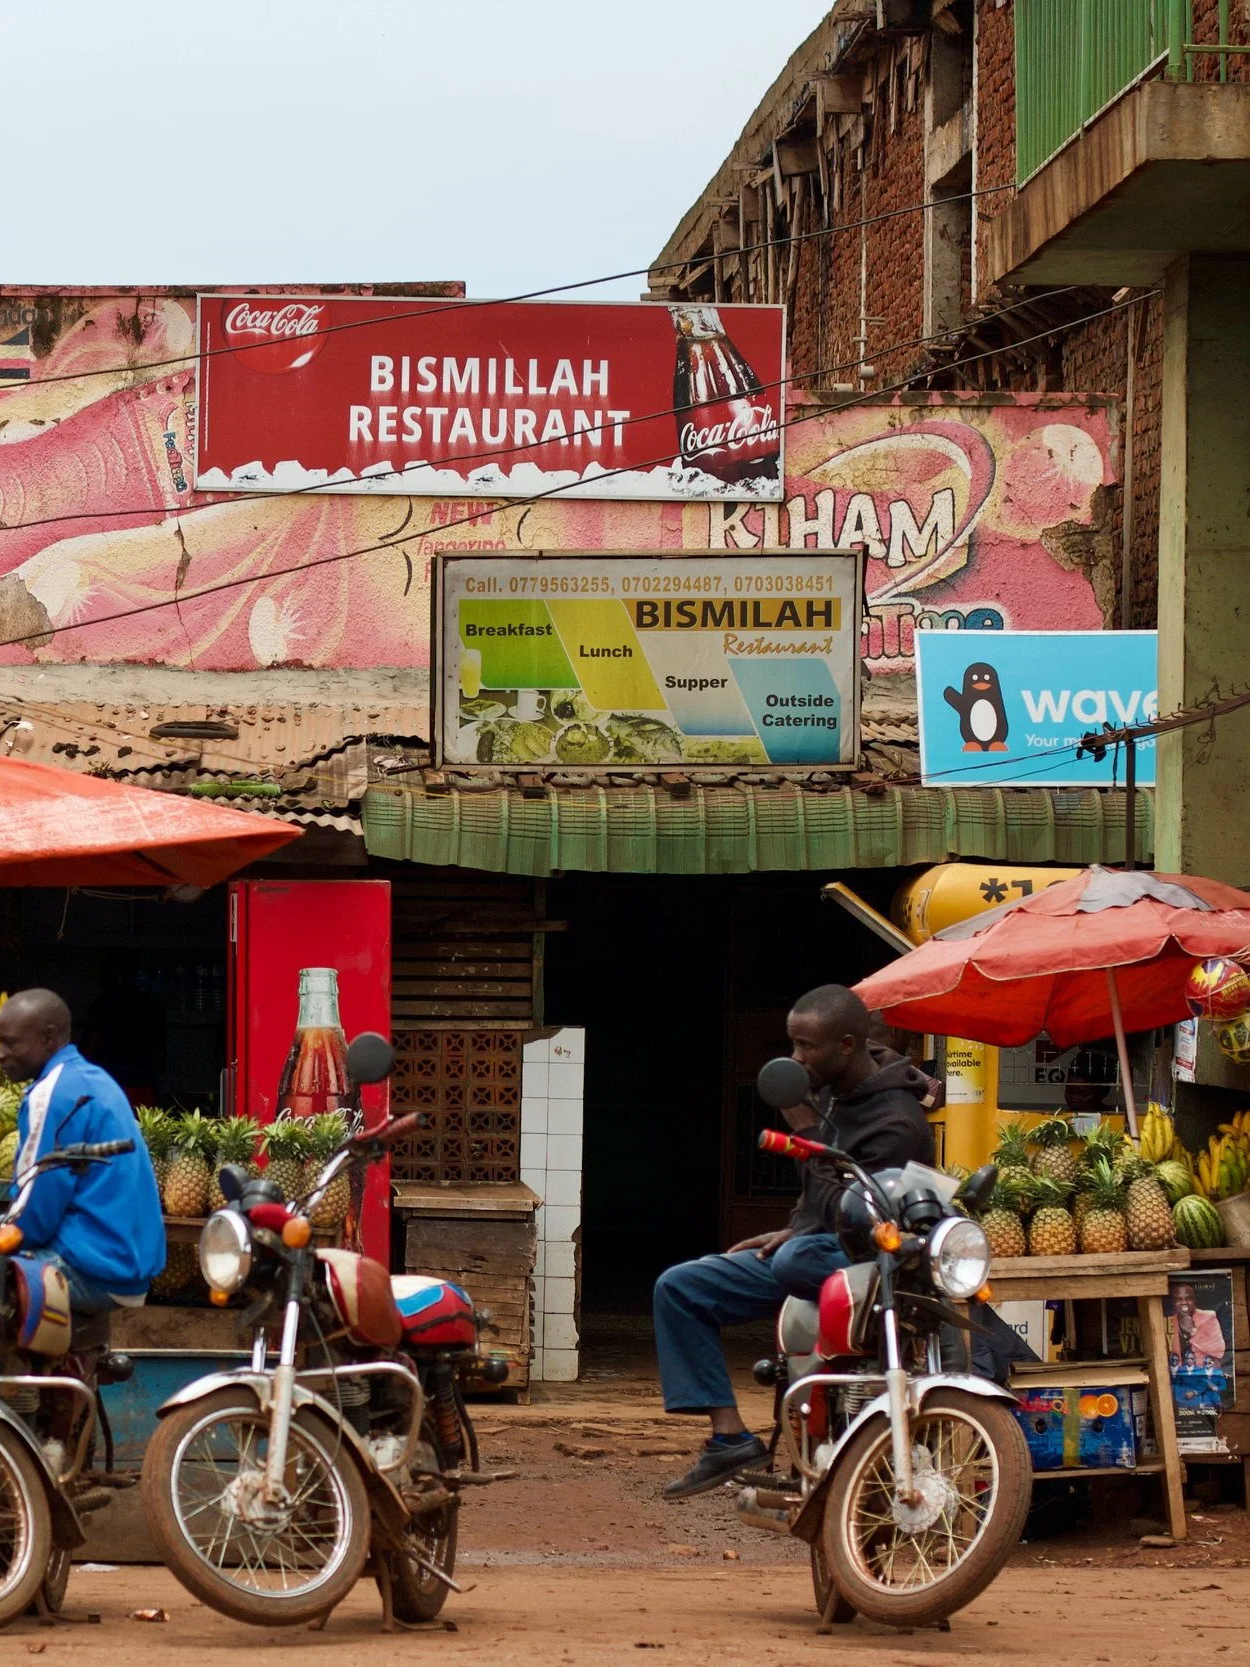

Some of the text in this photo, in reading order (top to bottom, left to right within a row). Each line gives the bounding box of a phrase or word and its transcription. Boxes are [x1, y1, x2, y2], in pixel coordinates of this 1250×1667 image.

[225, 303, 325, 336] Coca-Cola
[370, 355, 609, 396] BISMILLAH
[349, 405, 630, 446] RESTAURANT
[680, 404, 779, 462] Coca-Cola
[430, 501, 495, 525] NEW
[465, 575, 833, 595] Call. 0779563255, 0702294487, 0703038451
[636, 600, 832, 628] BISMILAH
[465, 623, 553, 637] Breakfast
[579, 645, 633, 658] Lunch
[722, 632, 833, 655] Restaurant
[665, 675, 728, 691] Supper
[766, 694, 834, 707] Outside
[762, 713, 837, 730] Catering
[1025, 733, 1060, 747] Your
